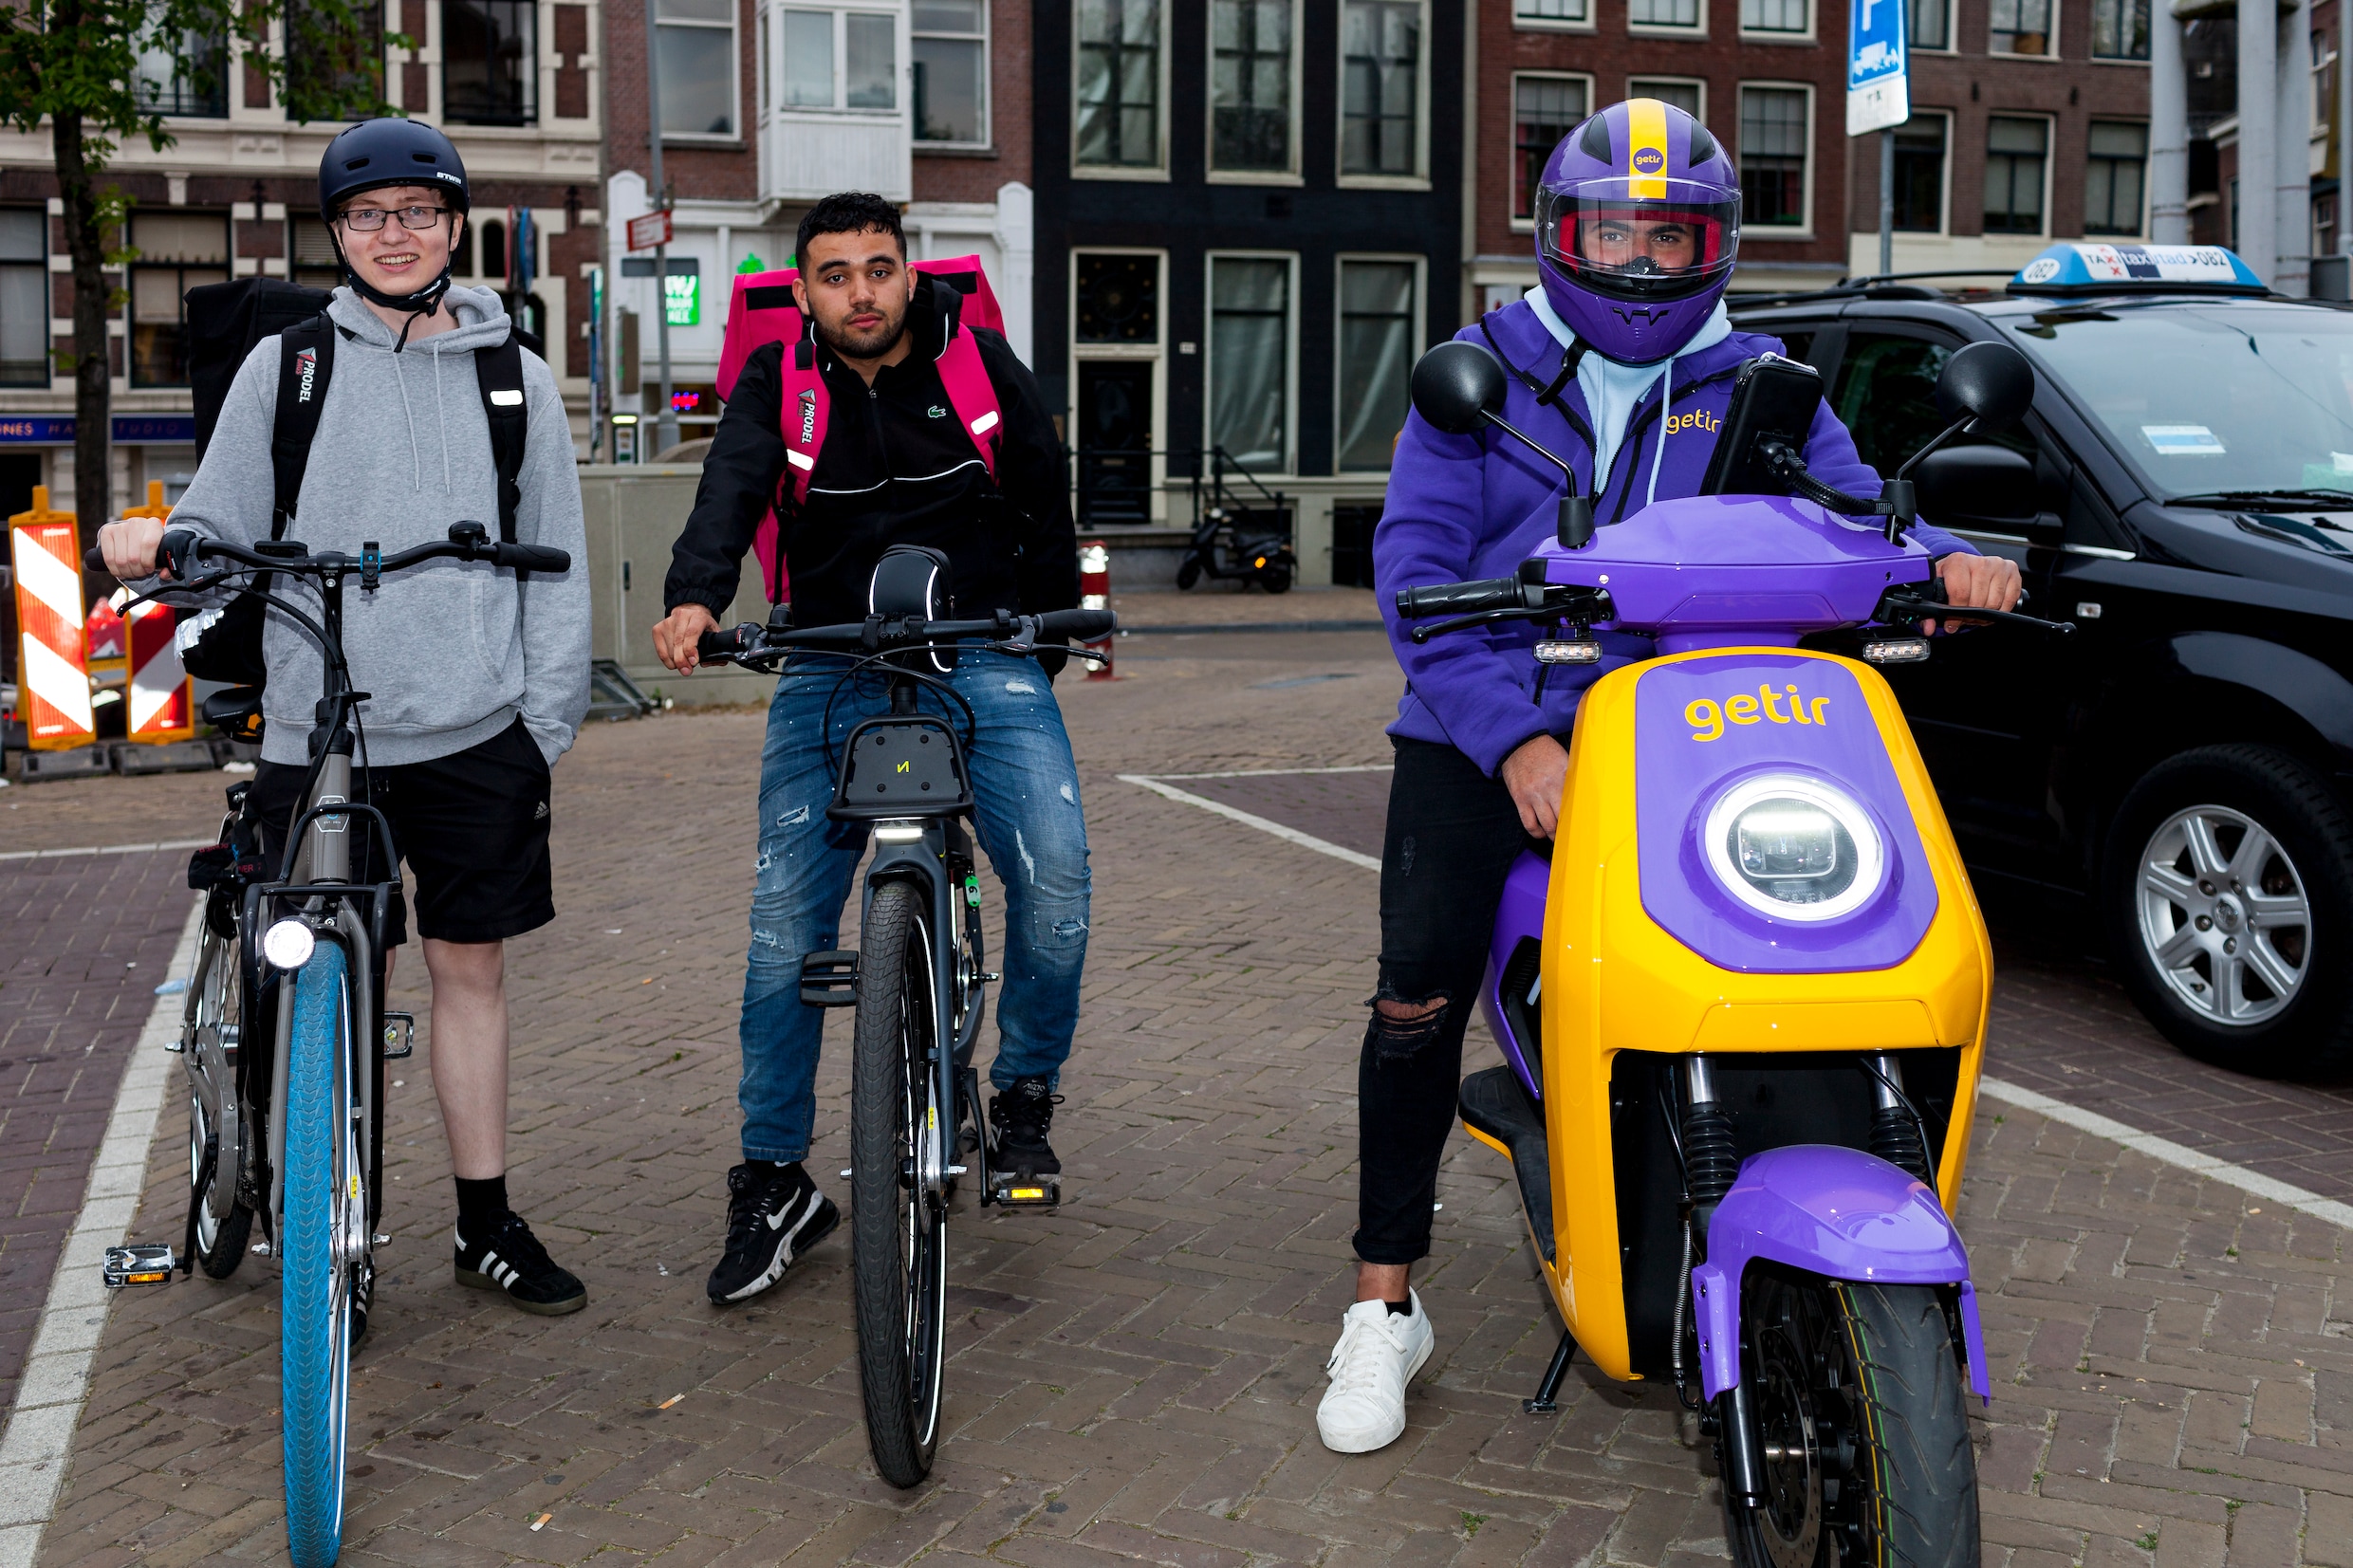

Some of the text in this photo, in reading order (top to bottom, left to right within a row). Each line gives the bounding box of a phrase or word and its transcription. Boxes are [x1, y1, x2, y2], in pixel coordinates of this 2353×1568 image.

[1636, 155, 1661, 165] getir
[299, 360, 316, 403] PRODEL
[801, 402, 816, 444] PRODEL
[1666, 409, 1721, 434] getir
[1684, 684, 1830, 742] getir
